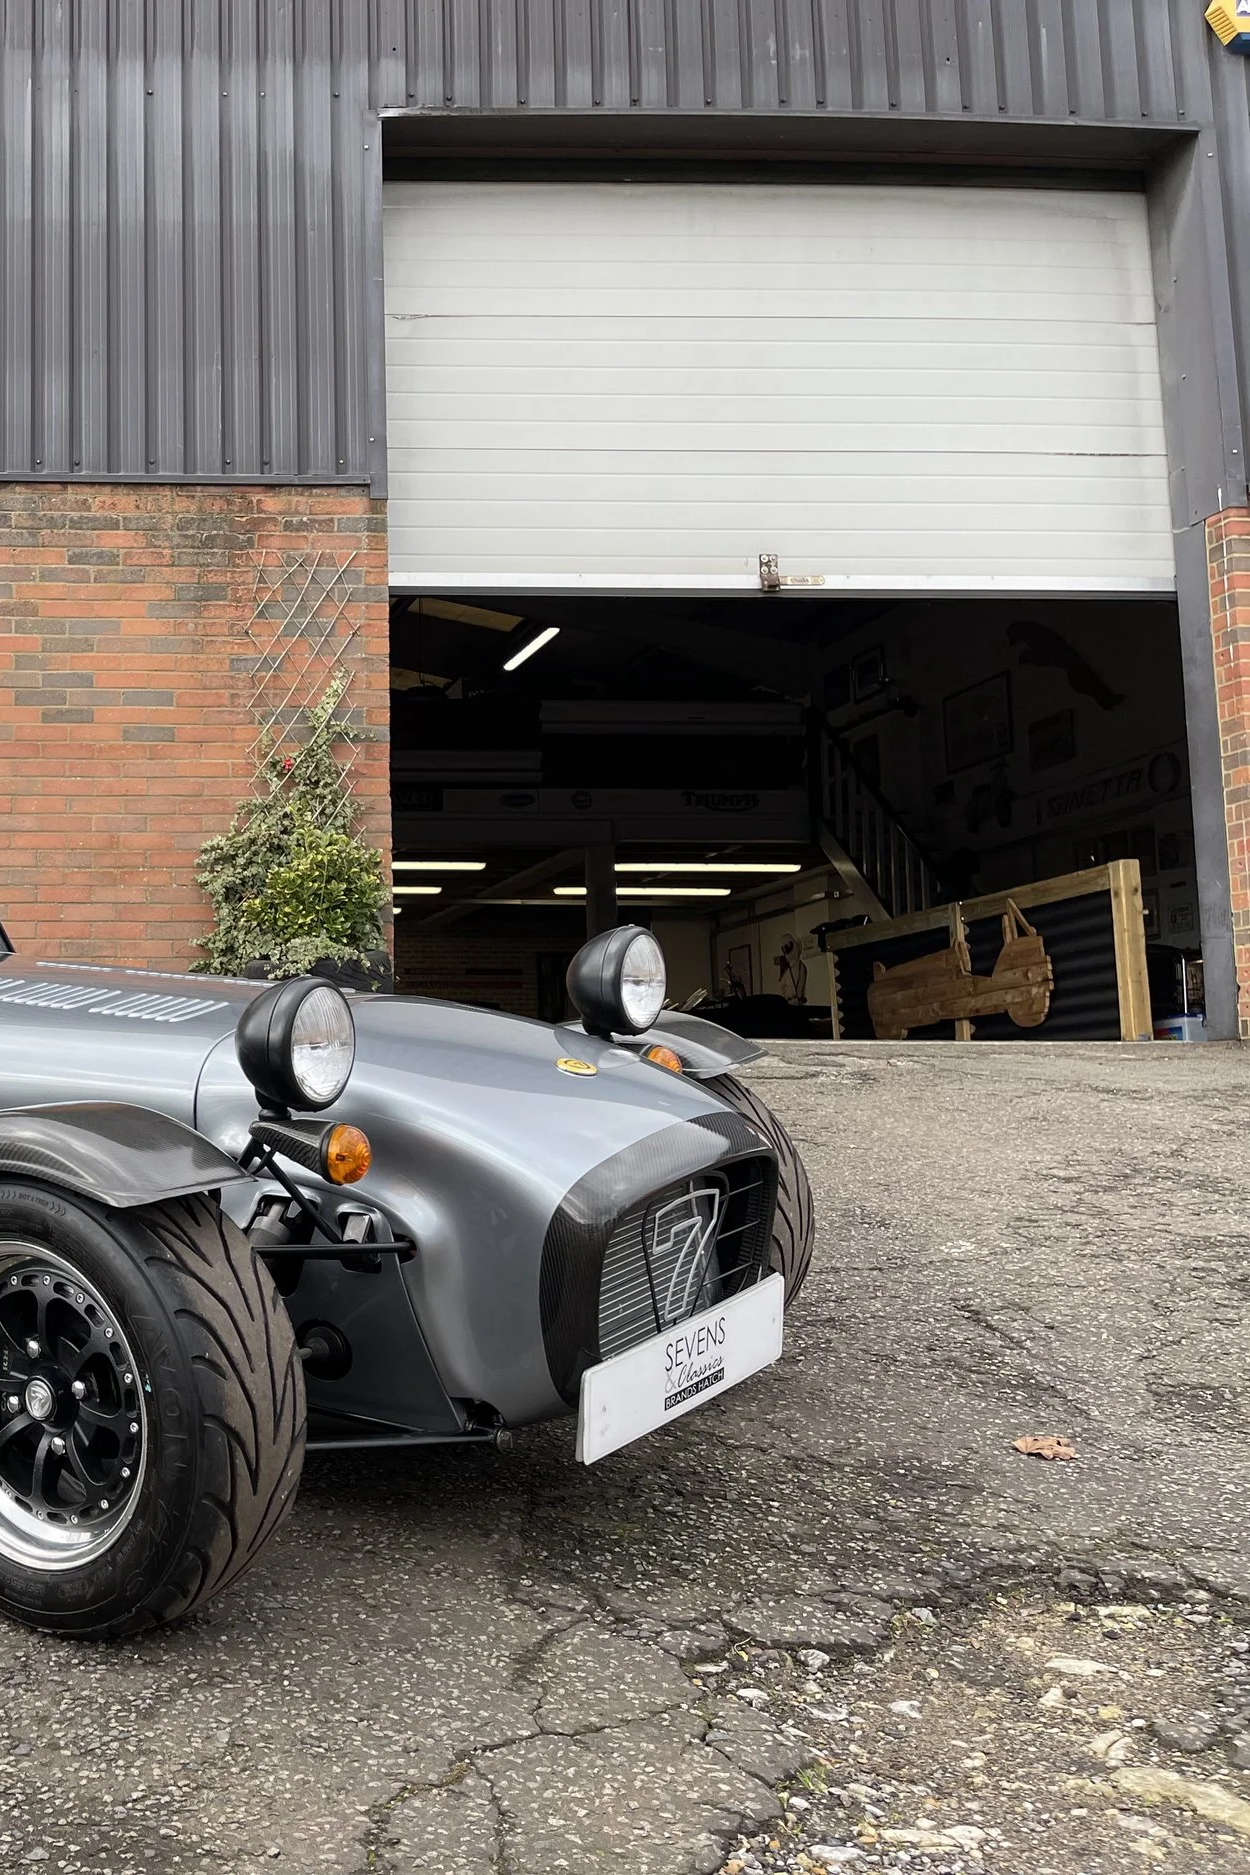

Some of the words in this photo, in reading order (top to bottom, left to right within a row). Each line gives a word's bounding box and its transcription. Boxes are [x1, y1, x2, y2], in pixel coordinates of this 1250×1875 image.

[665, 1317, 726, 1372] SEVENS
[664, 1370, 677, 1394] &
[677, 1355, 724, 1388] Classics
[665, 1384, 697, 1409] BRANDS
[697, 1369, 725, 1392] HATCH
